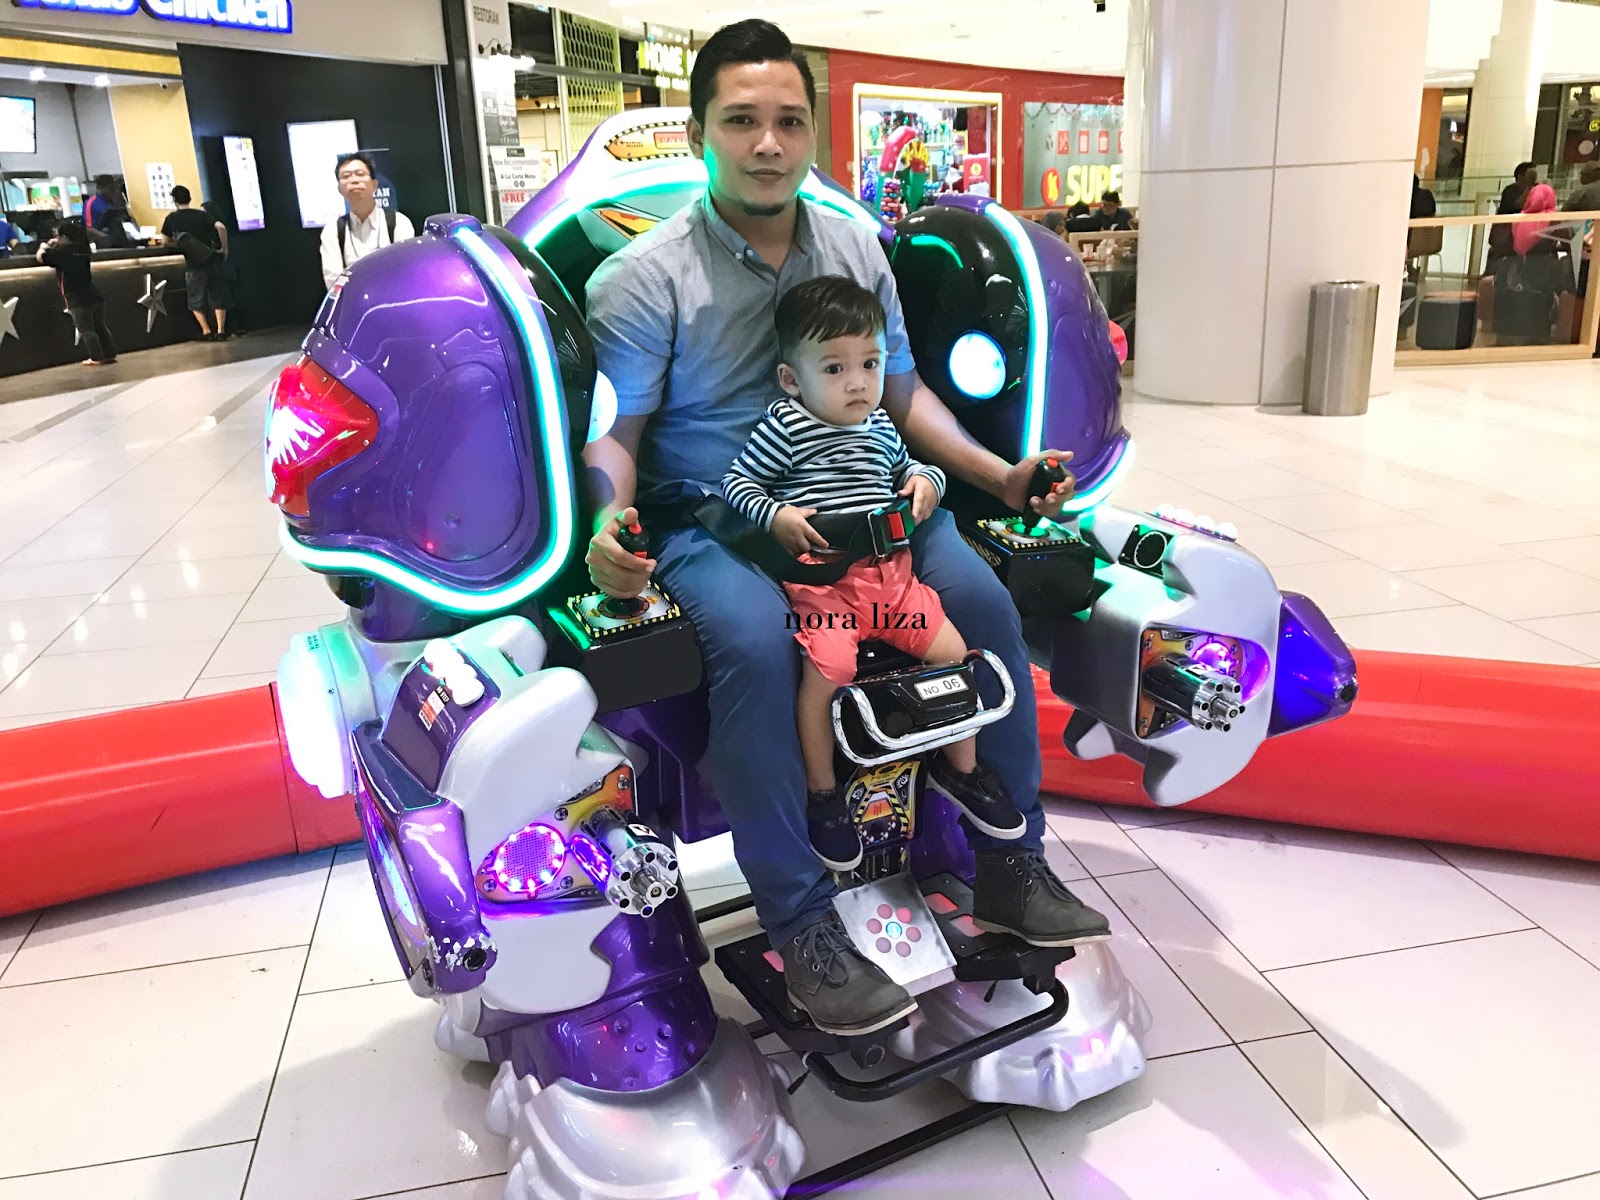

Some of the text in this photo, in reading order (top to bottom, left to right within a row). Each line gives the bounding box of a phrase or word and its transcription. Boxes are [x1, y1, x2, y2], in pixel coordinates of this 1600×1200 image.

[473, 5, 500, 25] RESTORAN
[644, 40, 684, 76] HOME
[1066, 164, 1124, 206] SUPE
[923, 678, 961, 696] NO. 06
